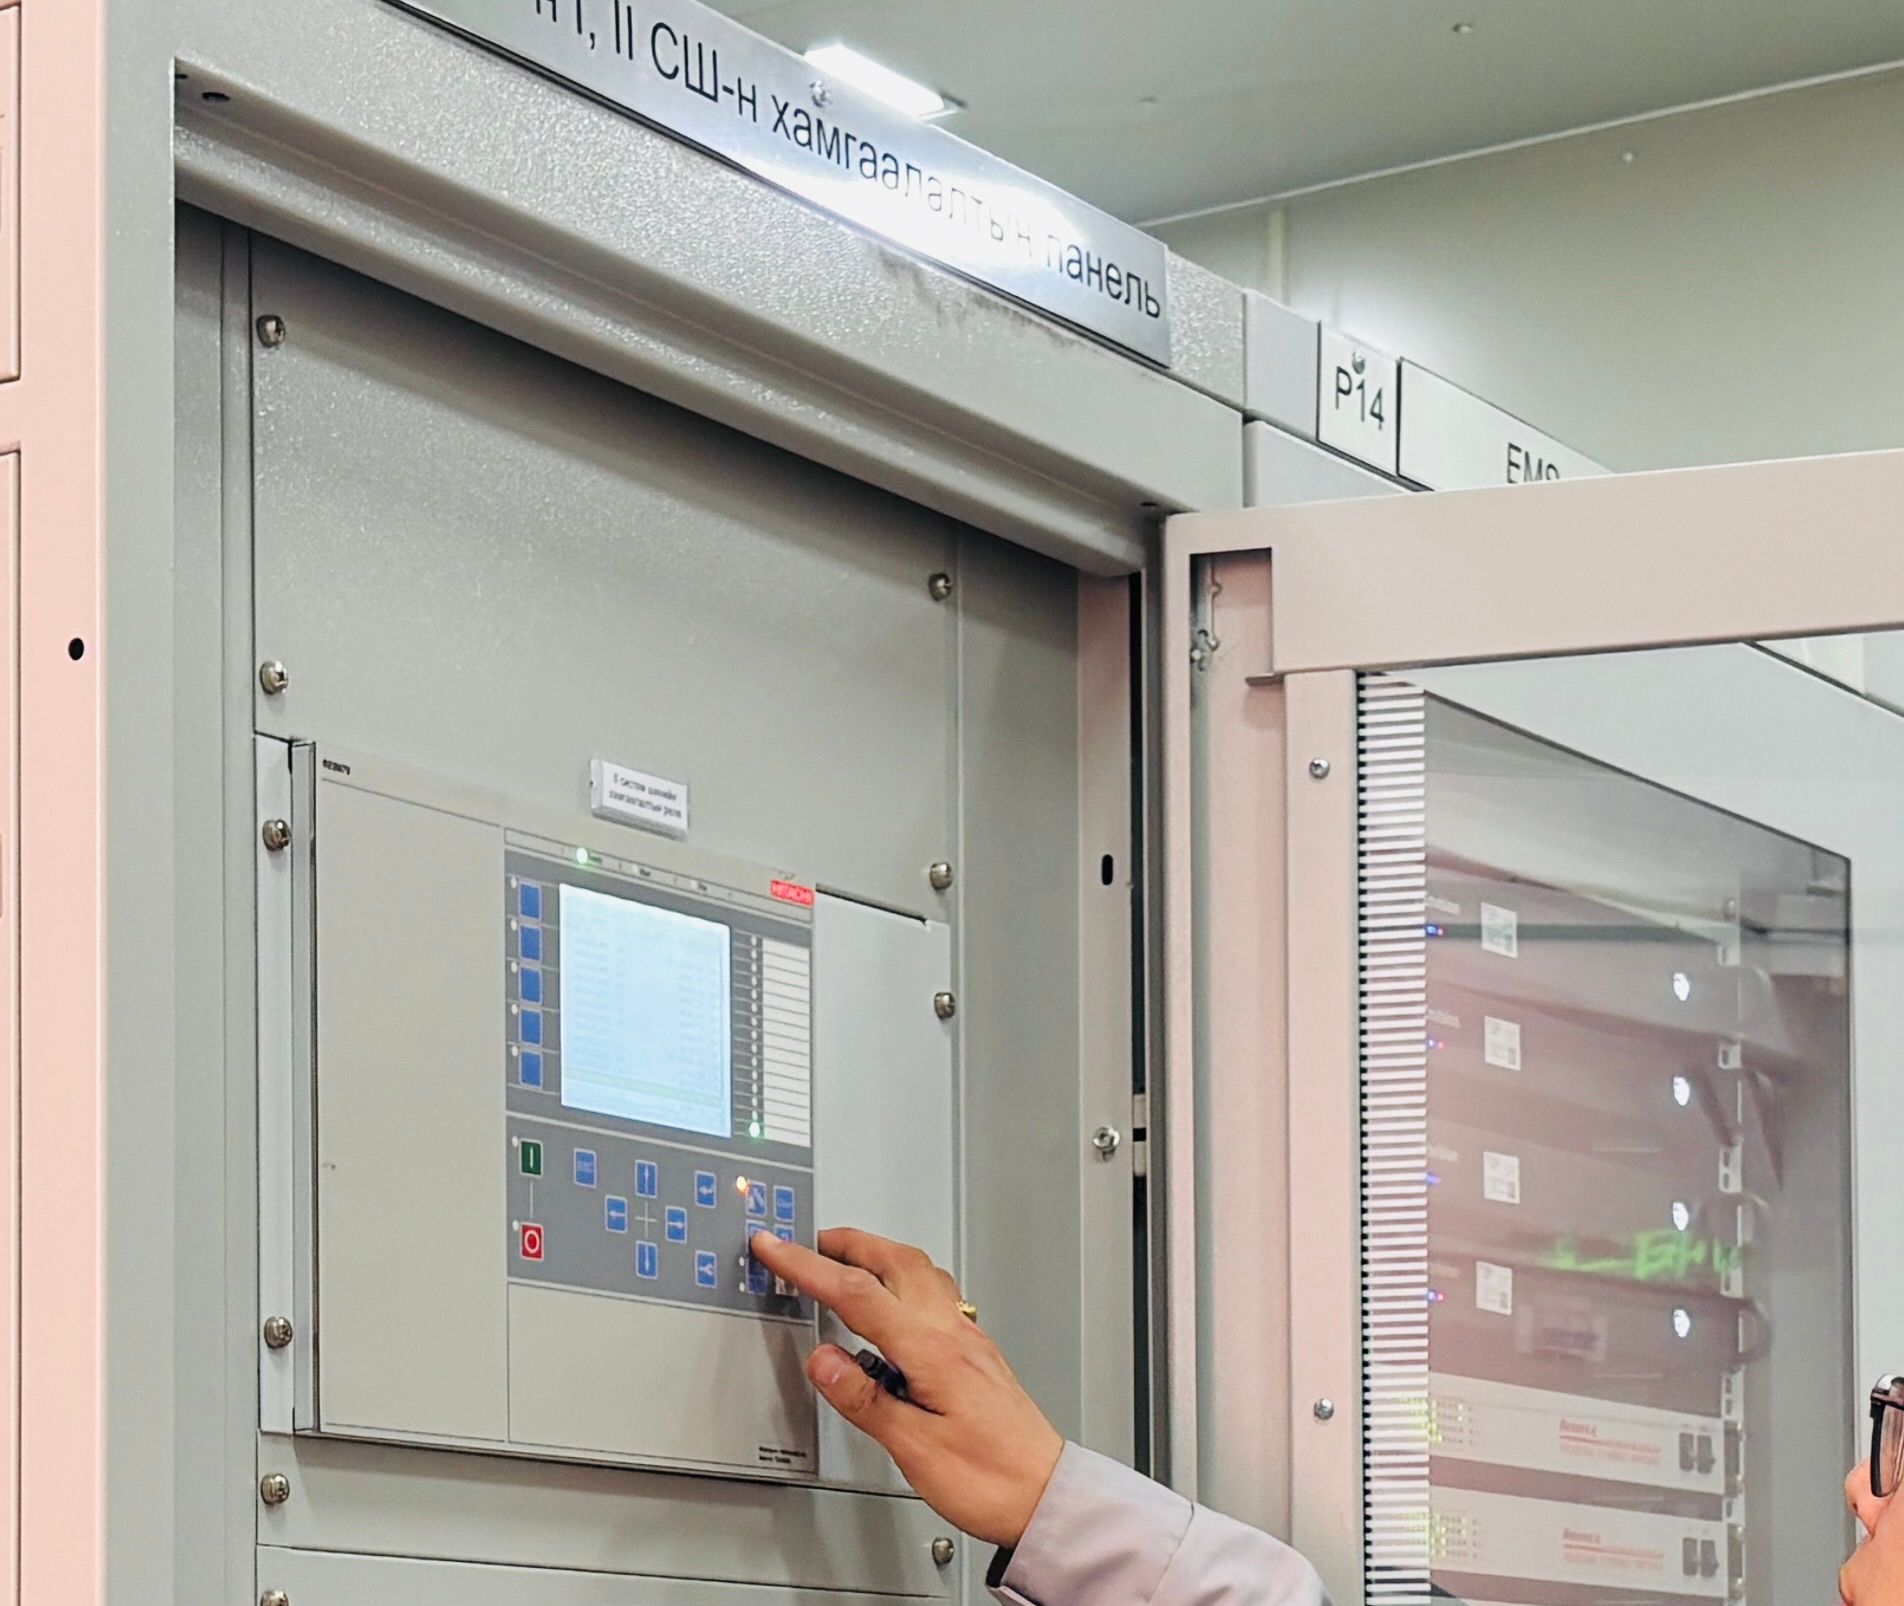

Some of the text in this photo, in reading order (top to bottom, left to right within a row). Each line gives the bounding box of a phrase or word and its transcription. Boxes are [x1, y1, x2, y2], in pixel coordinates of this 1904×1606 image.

[651, 22, 757, 122] СШ-н
[771, 94, 1033, 258] хамгаалалтын
[1047, 234, 1161, 319] панель
[1335, 365, 1385, 431] P14
